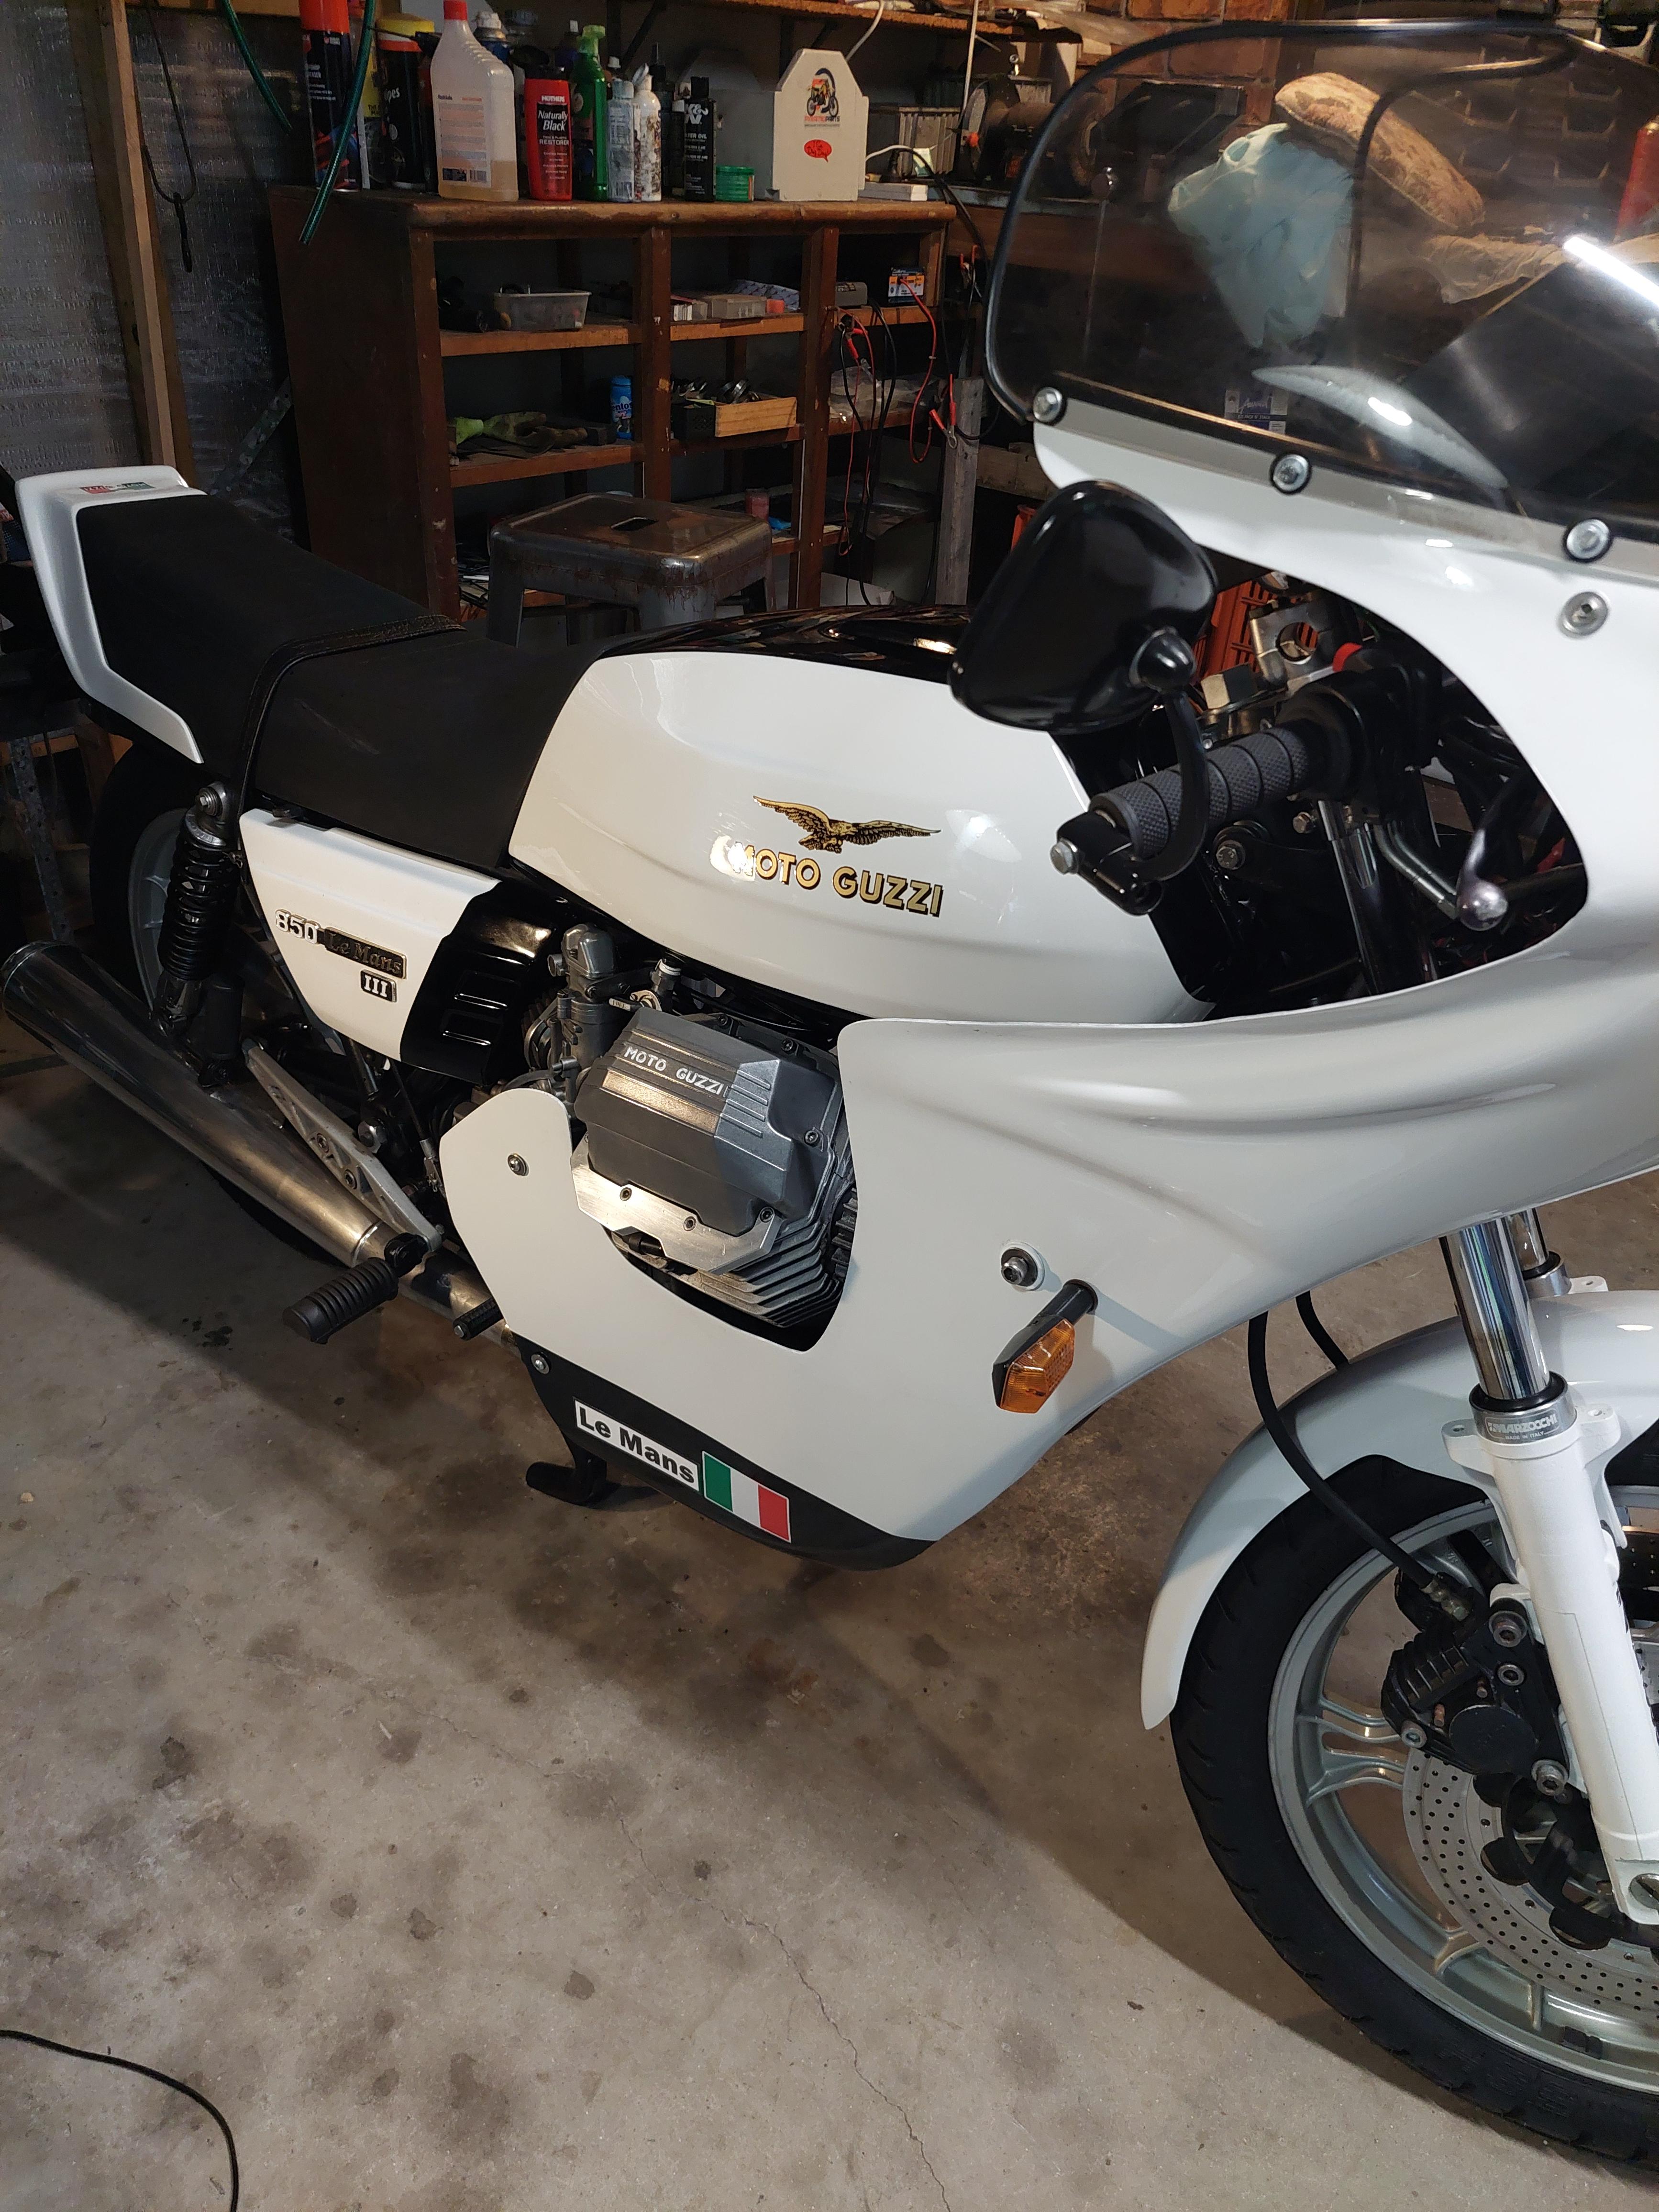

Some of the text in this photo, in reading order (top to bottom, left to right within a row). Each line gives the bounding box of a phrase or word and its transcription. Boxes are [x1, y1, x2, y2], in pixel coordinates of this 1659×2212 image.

[384, 88, 400, 102] ipes
[538, 110, 568, 122] Naturally
[542, 120, 566, 132] Black
[612, 402, 632, 411] entos
[728, 841, 943, 918] MOTO GUZZI
[275, 909, 402, 974] 850 Le Mans
[364, 974, 388, 998] III
[624, 1046, 724, 1095] MOTO GUZZI
[1493, 1414, 1558, 1433] MARZOCCHI
[579, 1406, 695, 1483] Le Mans
